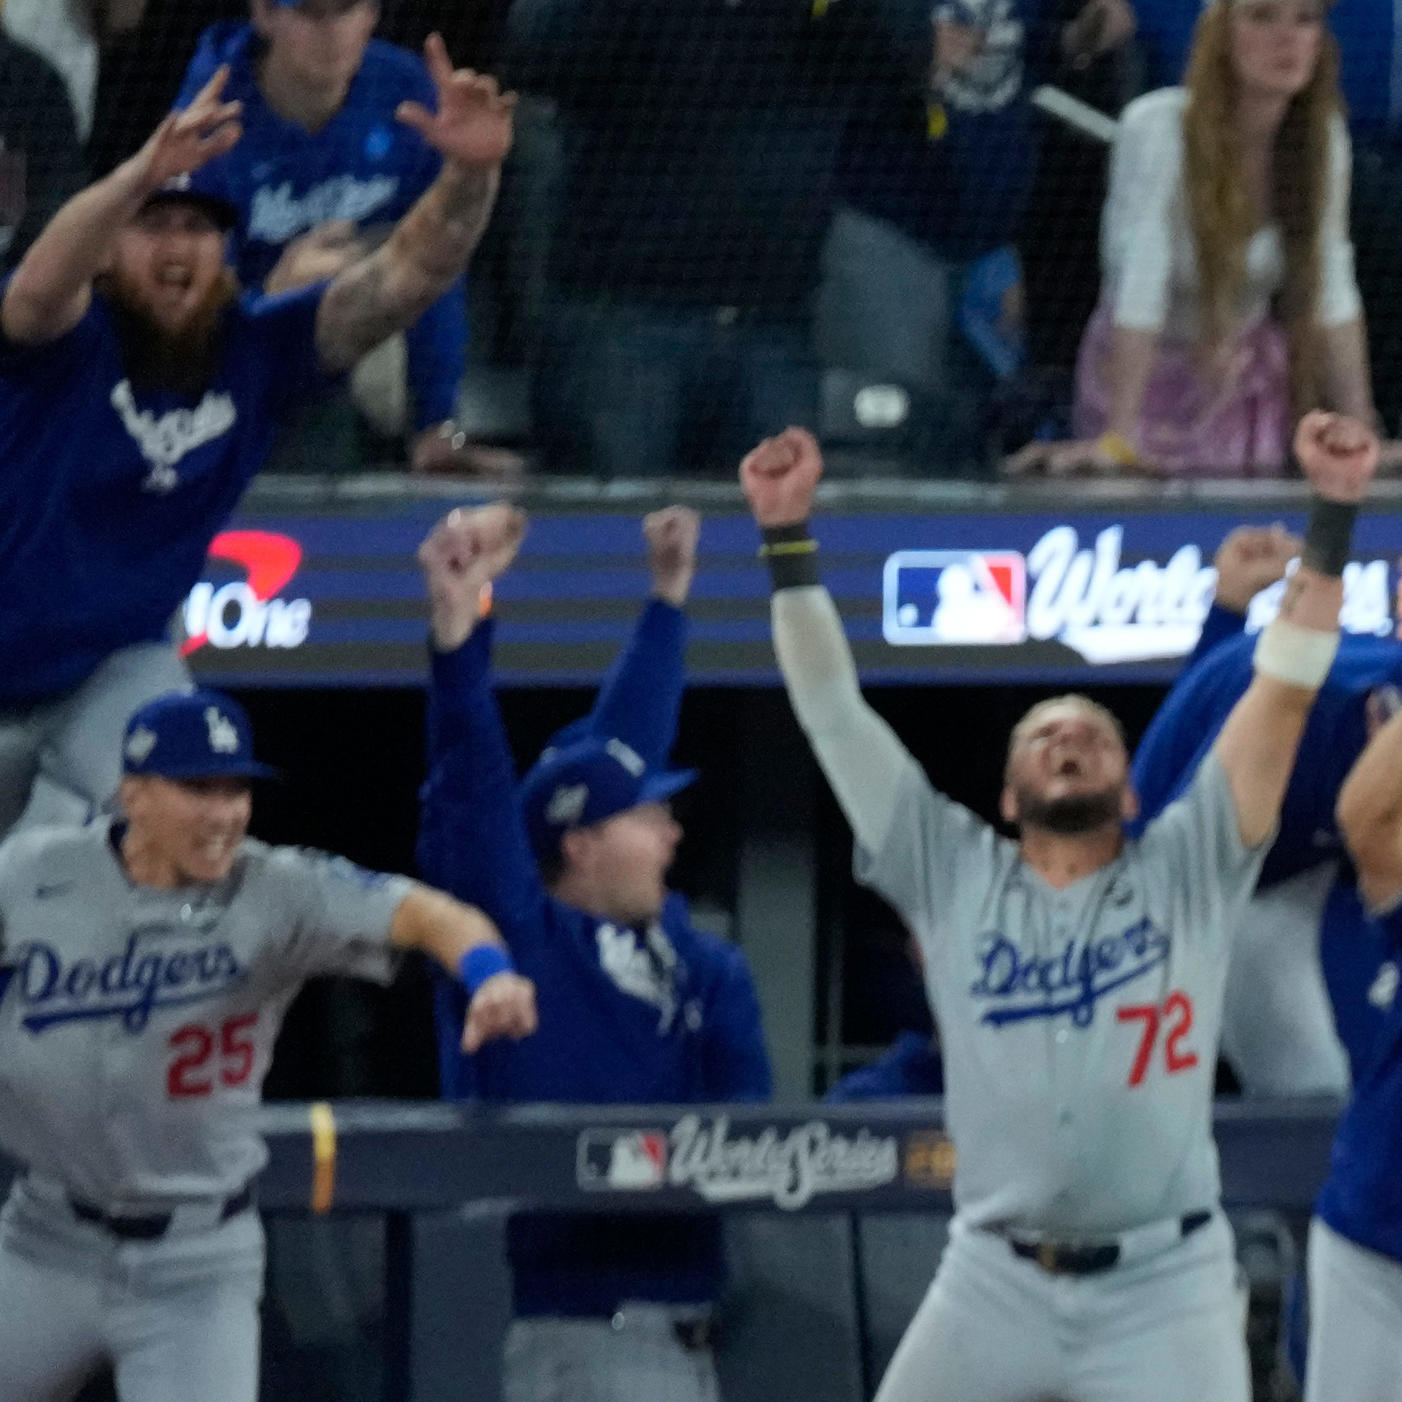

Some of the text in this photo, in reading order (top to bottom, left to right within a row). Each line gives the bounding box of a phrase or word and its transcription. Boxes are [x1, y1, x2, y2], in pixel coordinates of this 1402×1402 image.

[20, 932, 250, 1037] Dodgers
[970, 915, 1172, 1029] Dodgers
[167, 1011, 259, 1098] 25
[1116, 989, 1198, 1088] 72
